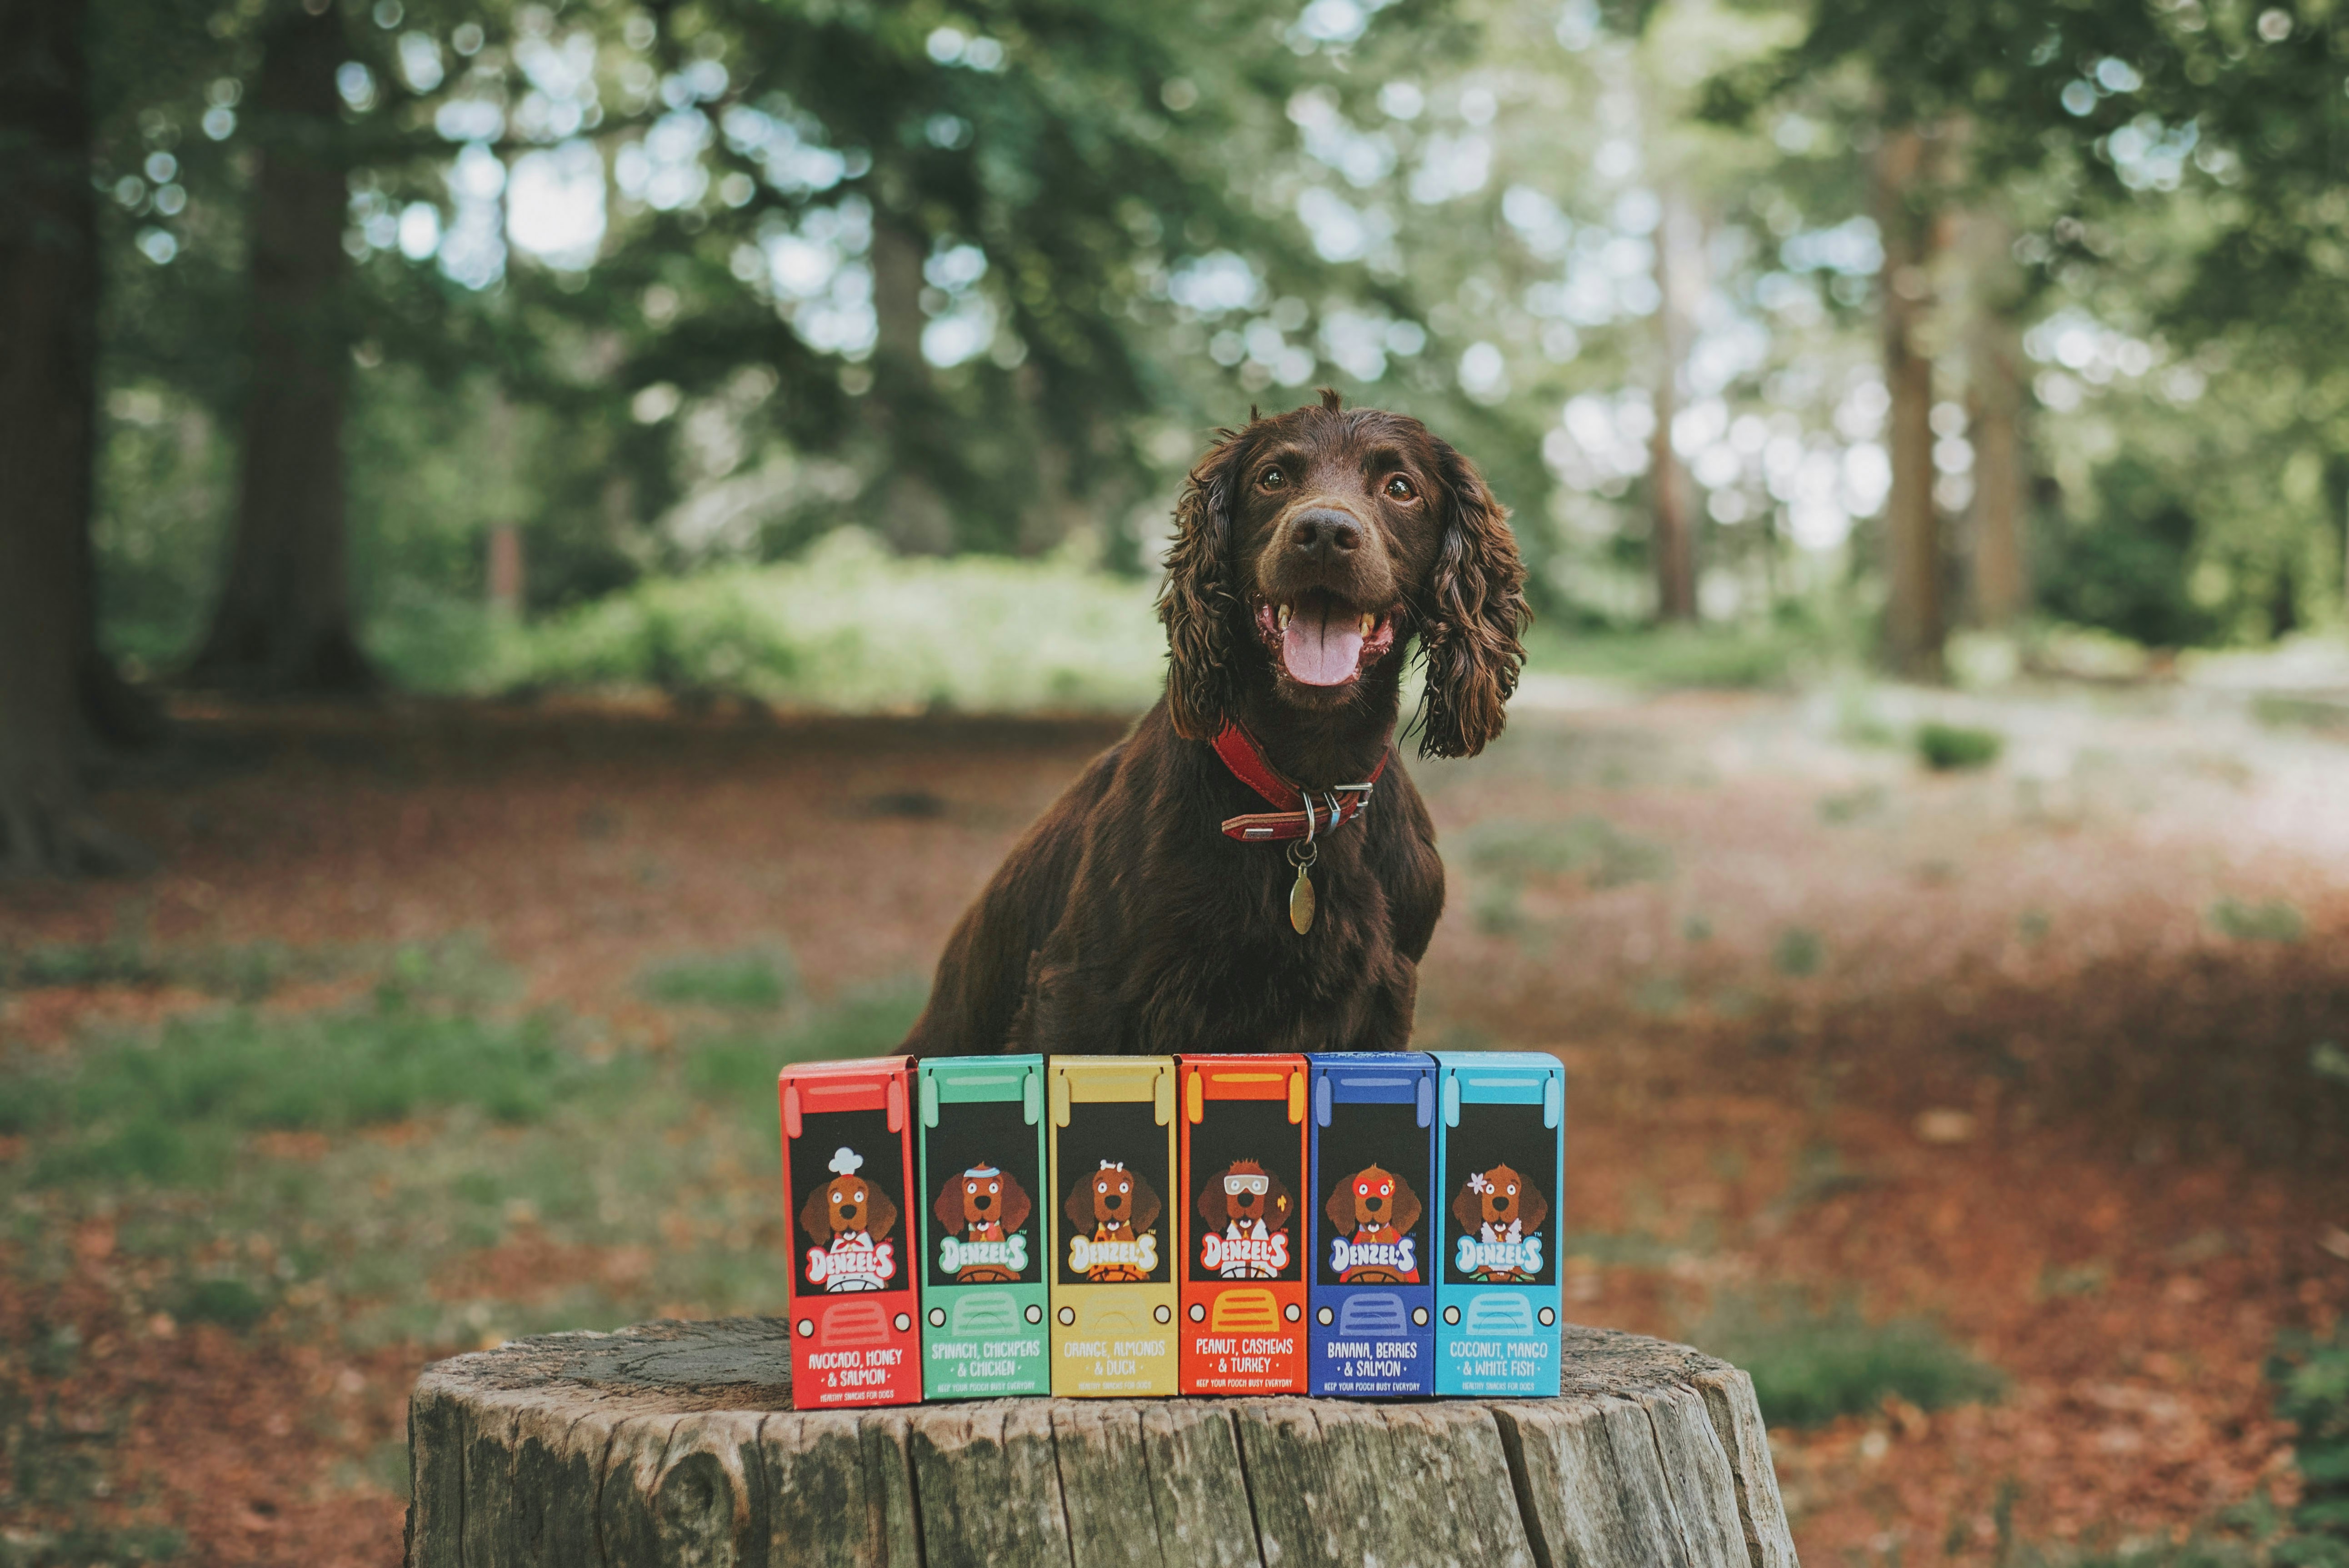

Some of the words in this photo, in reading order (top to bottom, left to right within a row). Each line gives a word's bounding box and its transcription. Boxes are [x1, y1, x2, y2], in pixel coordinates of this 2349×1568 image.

[942, 1237, 1025, 1271] DENZEL'S
[1072, 1237, 1155, 1270] DENZEL'S
[1204, 1234, 1286, 1267] DENZEL'S
[1332, 1238, 1414, 1271] DENZEL'S
[1459, 1239, 1540, 1271] DENZEL'S
[809, 1244, 893, 1281] DENZEL'S
[932, 1343, 981, 1360] SPINACH,
[983, 1340, 1040, 1358] CHICKPEAS
[1064, 1341, 1110, 1359] ORANGE,
[1114, 1340, 1165, 1357] ALMONDS
[1196, 1338, 1239, 1356] PEANUT,
[1242, 1338, 1293, 1354] CASHEWS
[1328, 1342, 1373, 1360] BANANA,
[1376, 1342, 1417, 1358] BERRIES
[1450, 1342, 1504, 1360] COCONUT,
[1507, 1342, 1548, 1358] MANGO
[809, 1351, 863, 1369] AVOCADO,
[866, 1348, 903, 1366] HONEY
[1094, 1361, 1103, 1375] &
[1107, 1360, 1135, 1375] DUCK
[1219, 1358, 1227, 1373] &
[1231, 1356, 1271, 1373] TURKEY
[958, 1363, 966, 1377] &
[970, 1360, 1015, 1377] CHICKEN
[1344, 1361, 1353, 1377] &
[1356, 1360, 1401, 1377] SALMON
[1463, 1361, 1471, 1375] &
[1475, 1360, 1507, 1376] WHITE
[1511, 1360, 1534, 1376] FISH
[828, 1372, 837, 1387] &
[840, 1368, 885, 1387] SALMON
[1079, 1382, 1100, 1390] HEALTHY
[1102, 1382, 1122, 1390] SNACKS
[1124, 1381, 1135, 1389] FOR
[1136, 1381, 1151, 1389] DOGS
[1196, 1379, 1209, 1388] KEEP
[1211, 1379, 1226, 1387] YOUR
[1228, 1379, 1247, 1388] POOCH
[1249, 1379, 1263, 1388] BUSY
[1265, 1379, 1293, 1388] EVERYDAY
[1324, 1382, 1337, 1391] KEEP
[1339, 1382, 1354, 1391] YOUR
[1355, 1382, 1374, 1391] POOCH
[1376, 1382, 1391, 1391] BUSY
[1393, 1382, 1420, 1391] EVERYDAY
[1462, 1382, 1484, 1390] HEALTHY
[1486, 1382, 1506, 1390] SNACKS
[1508, 1382, 1518, 1390] FOR
[1520, 1382, 1534, 1391] DOGS
[820, 1393, 842, 1403] HEALTHY
[845, 1392, 865, 1401] SNACKS
[866, 1391, 877, 1399] FOR
[879, 1389, 894, 1398] DOGS
[938, 1384, 950, 1393] KEEP
[953, 1383, 968, 1392] YOUR
[970, 1383, 989, 1391] POOCH
[1007, 1382, 1035, 1390] EVERYDAY
